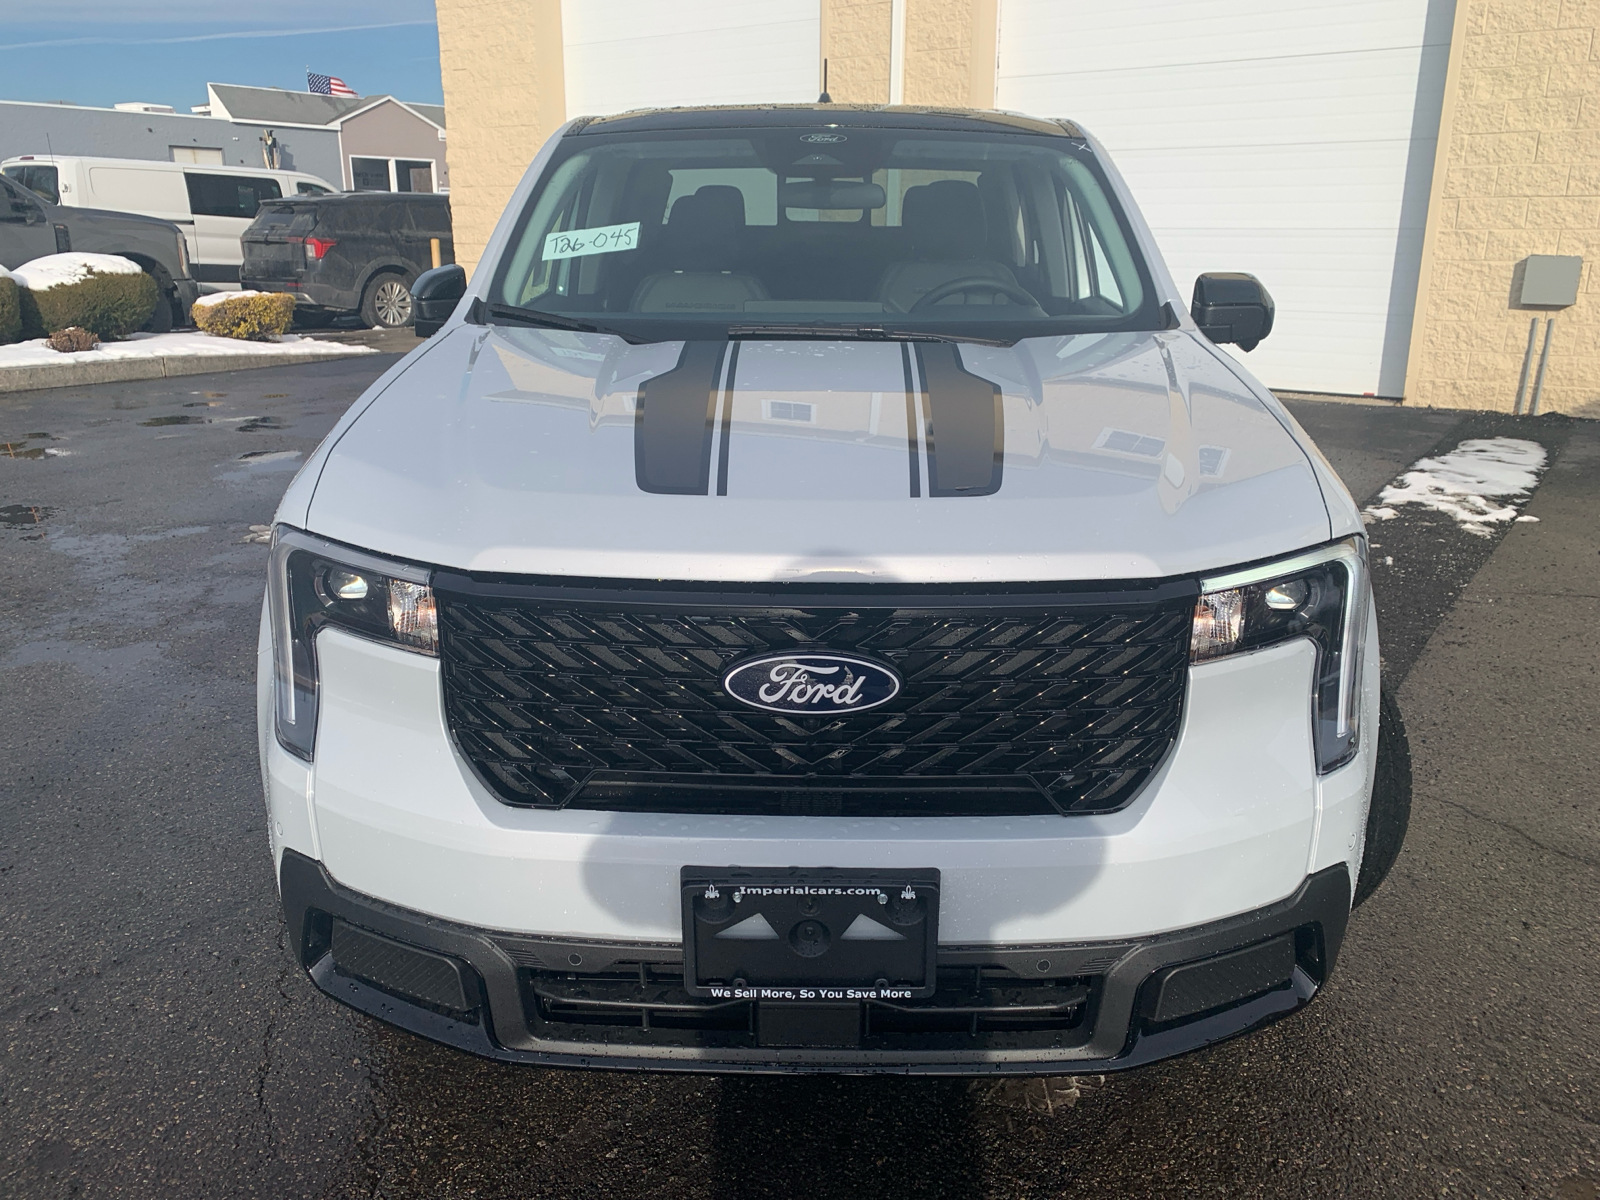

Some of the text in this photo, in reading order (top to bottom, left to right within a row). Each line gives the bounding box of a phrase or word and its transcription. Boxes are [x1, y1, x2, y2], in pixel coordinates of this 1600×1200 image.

[808, 133, 839, 142] Ford
[550, 227, 637, 254] T26-045
[758, 663, 867, 704] Ford
[739, 886, 881, 896] Imperialcars.com
[711, 988, 912, 1000] We Sell More, So You Save More
